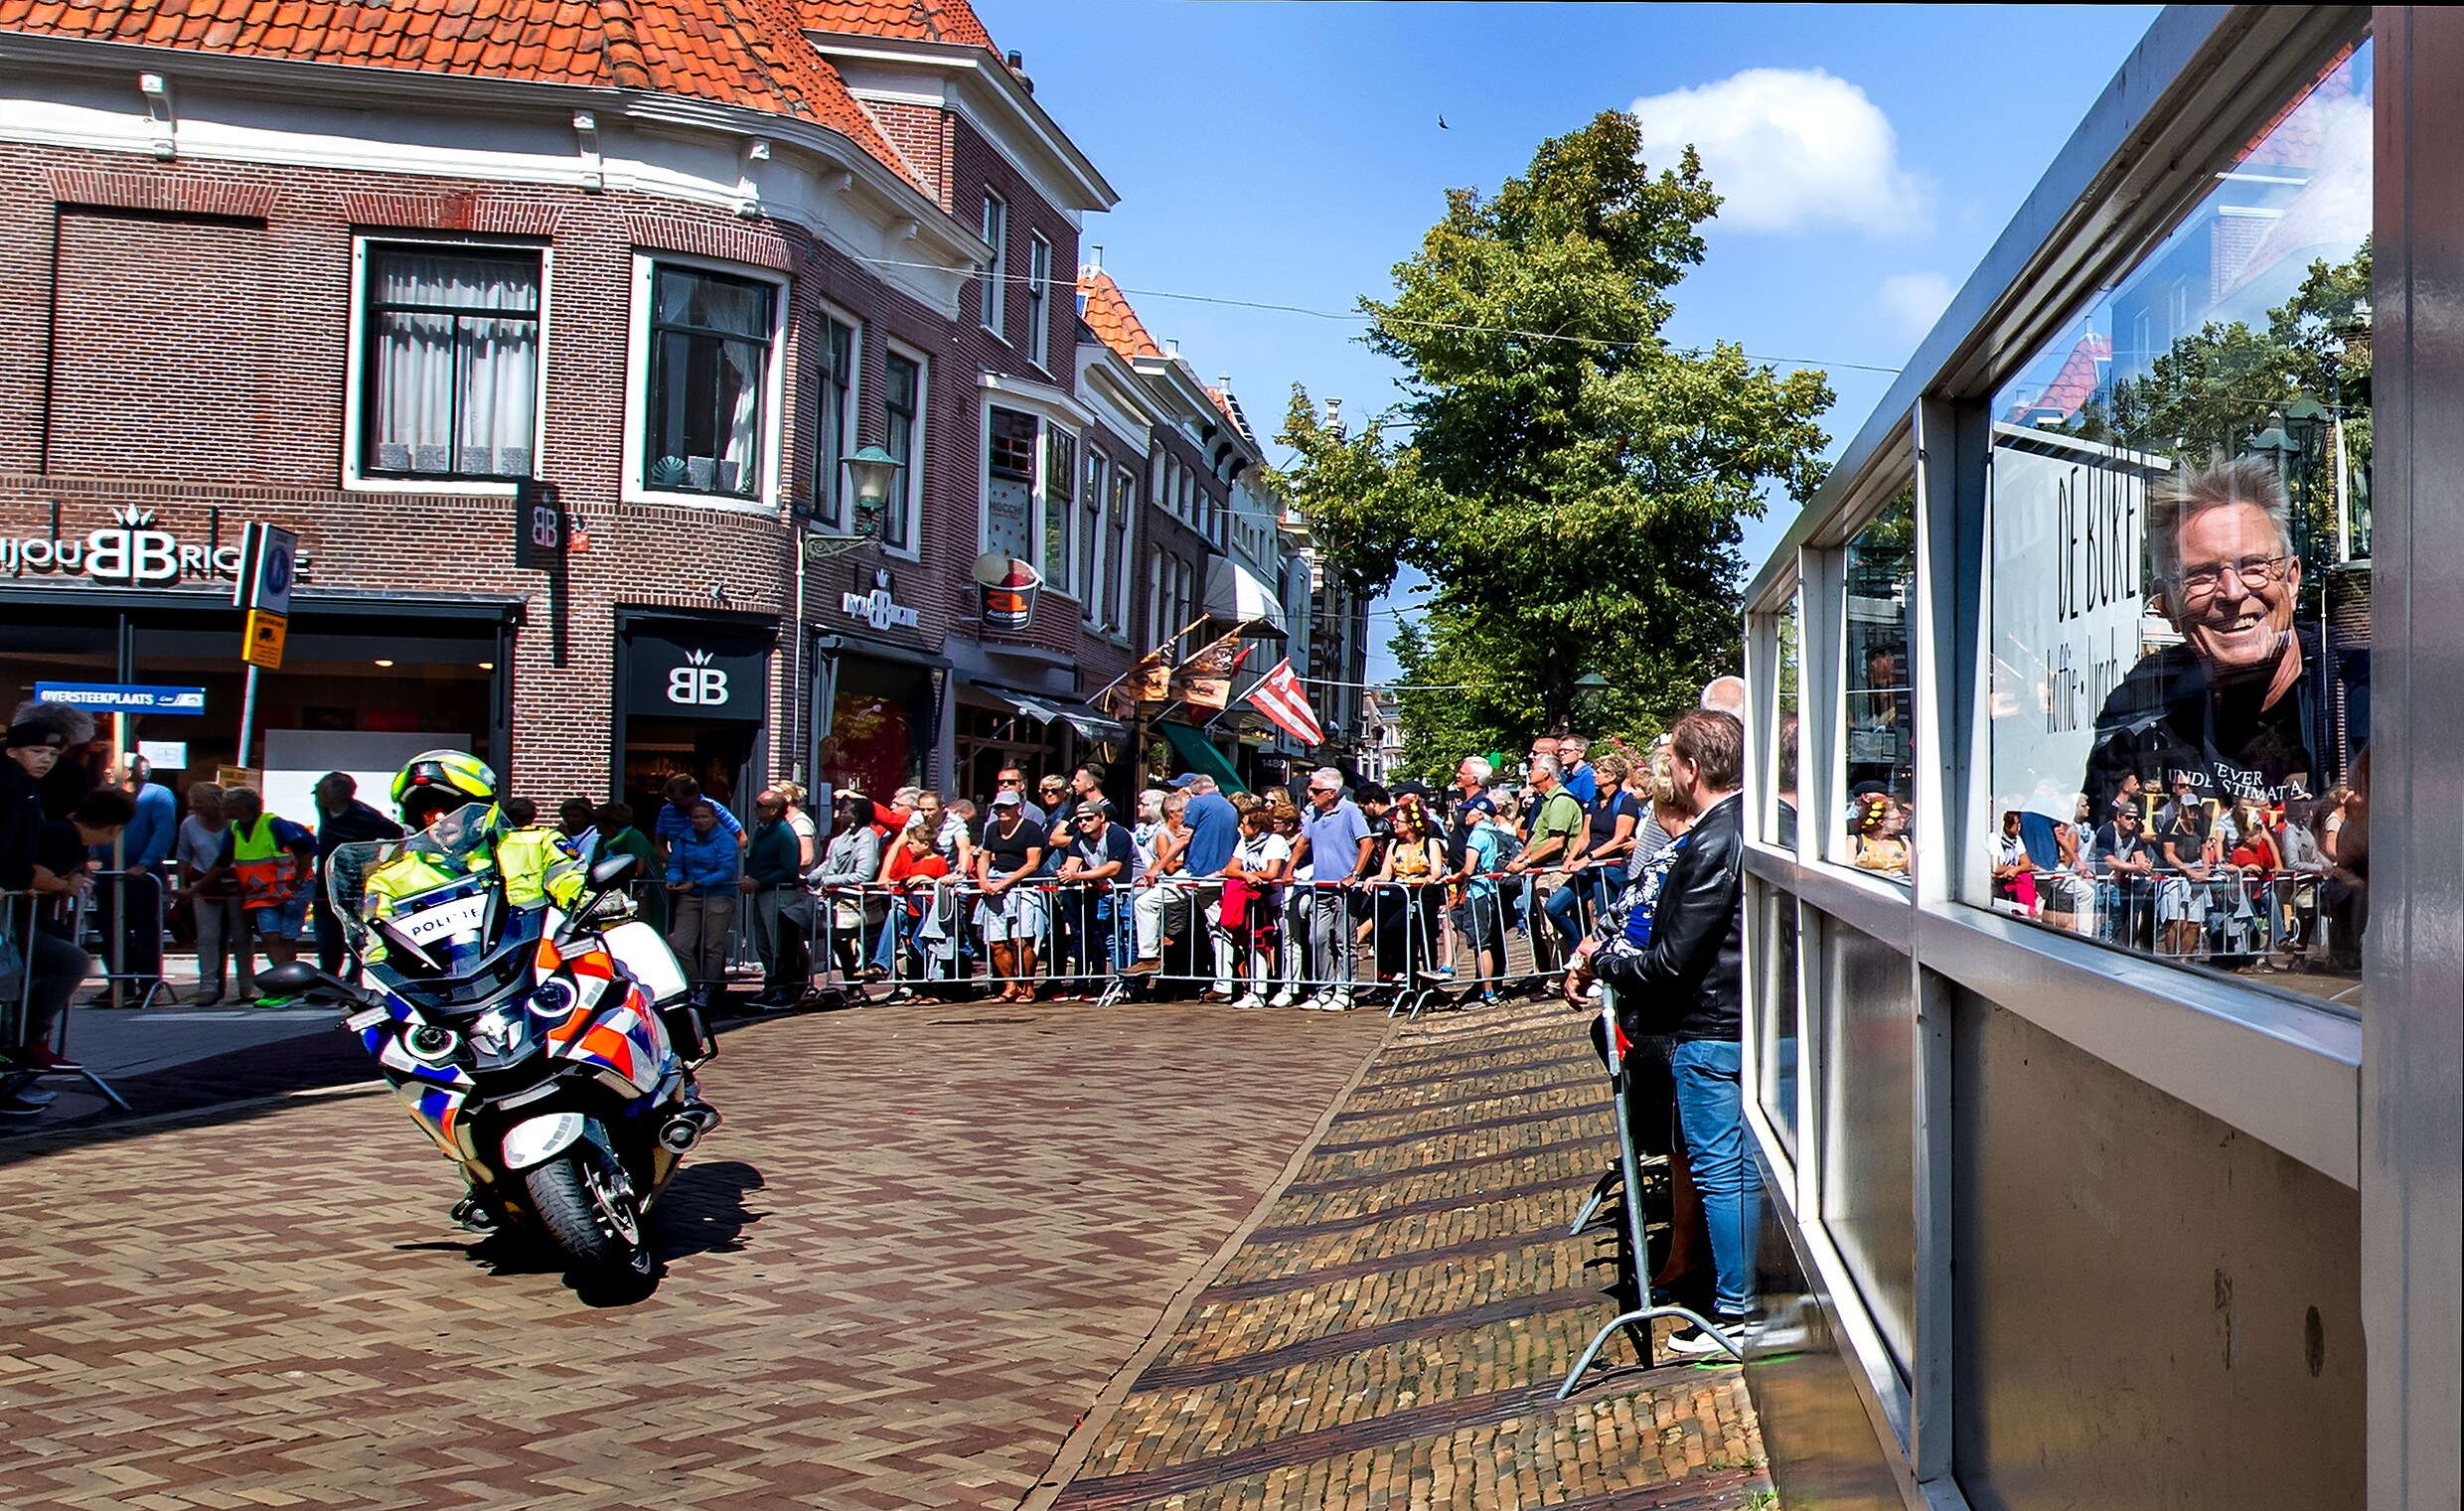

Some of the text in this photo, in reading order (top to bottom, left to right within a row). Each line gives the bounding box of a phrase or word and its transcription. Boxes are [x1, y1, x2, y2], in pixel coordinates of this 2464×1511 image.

[2059, 466, 2079, 623] DE
[41, 689, 154, 705] OVERSTEEKPLAATS
[2213, 761, 2263, 786] EVER
[412, 908, 481, 936] POLIIE
